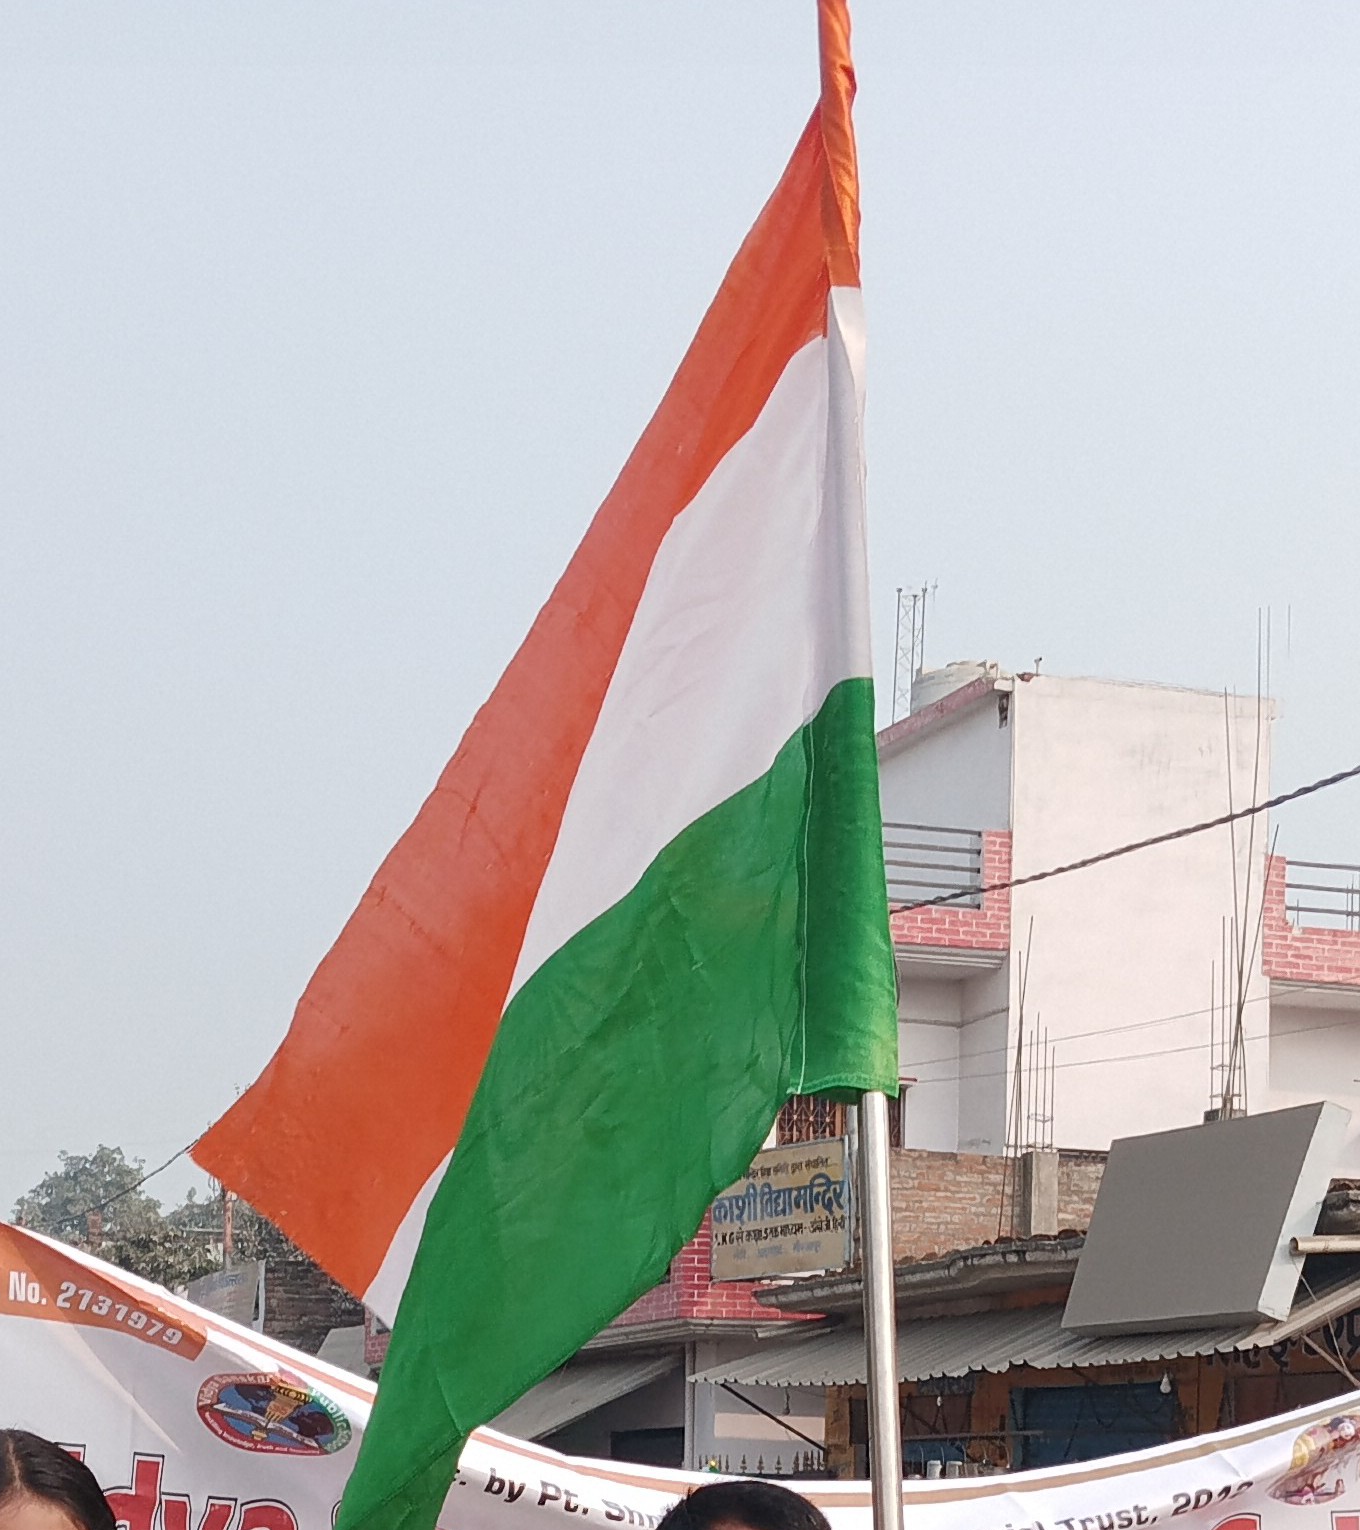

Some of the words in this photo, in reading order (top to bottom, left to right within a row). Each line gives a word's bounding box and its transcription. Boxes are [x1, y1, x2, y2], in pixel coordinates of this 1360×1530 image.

[713, 1182, 758, 1226] काशी
[760, 1182, 792, 1221] विद्या
[9, 1271, 47, 1305] No.
[56, 1281, 183, 1346] 2131979
[484, 1467, 526, 1503] by
[537, 1480, 589, 1515] Pt.
